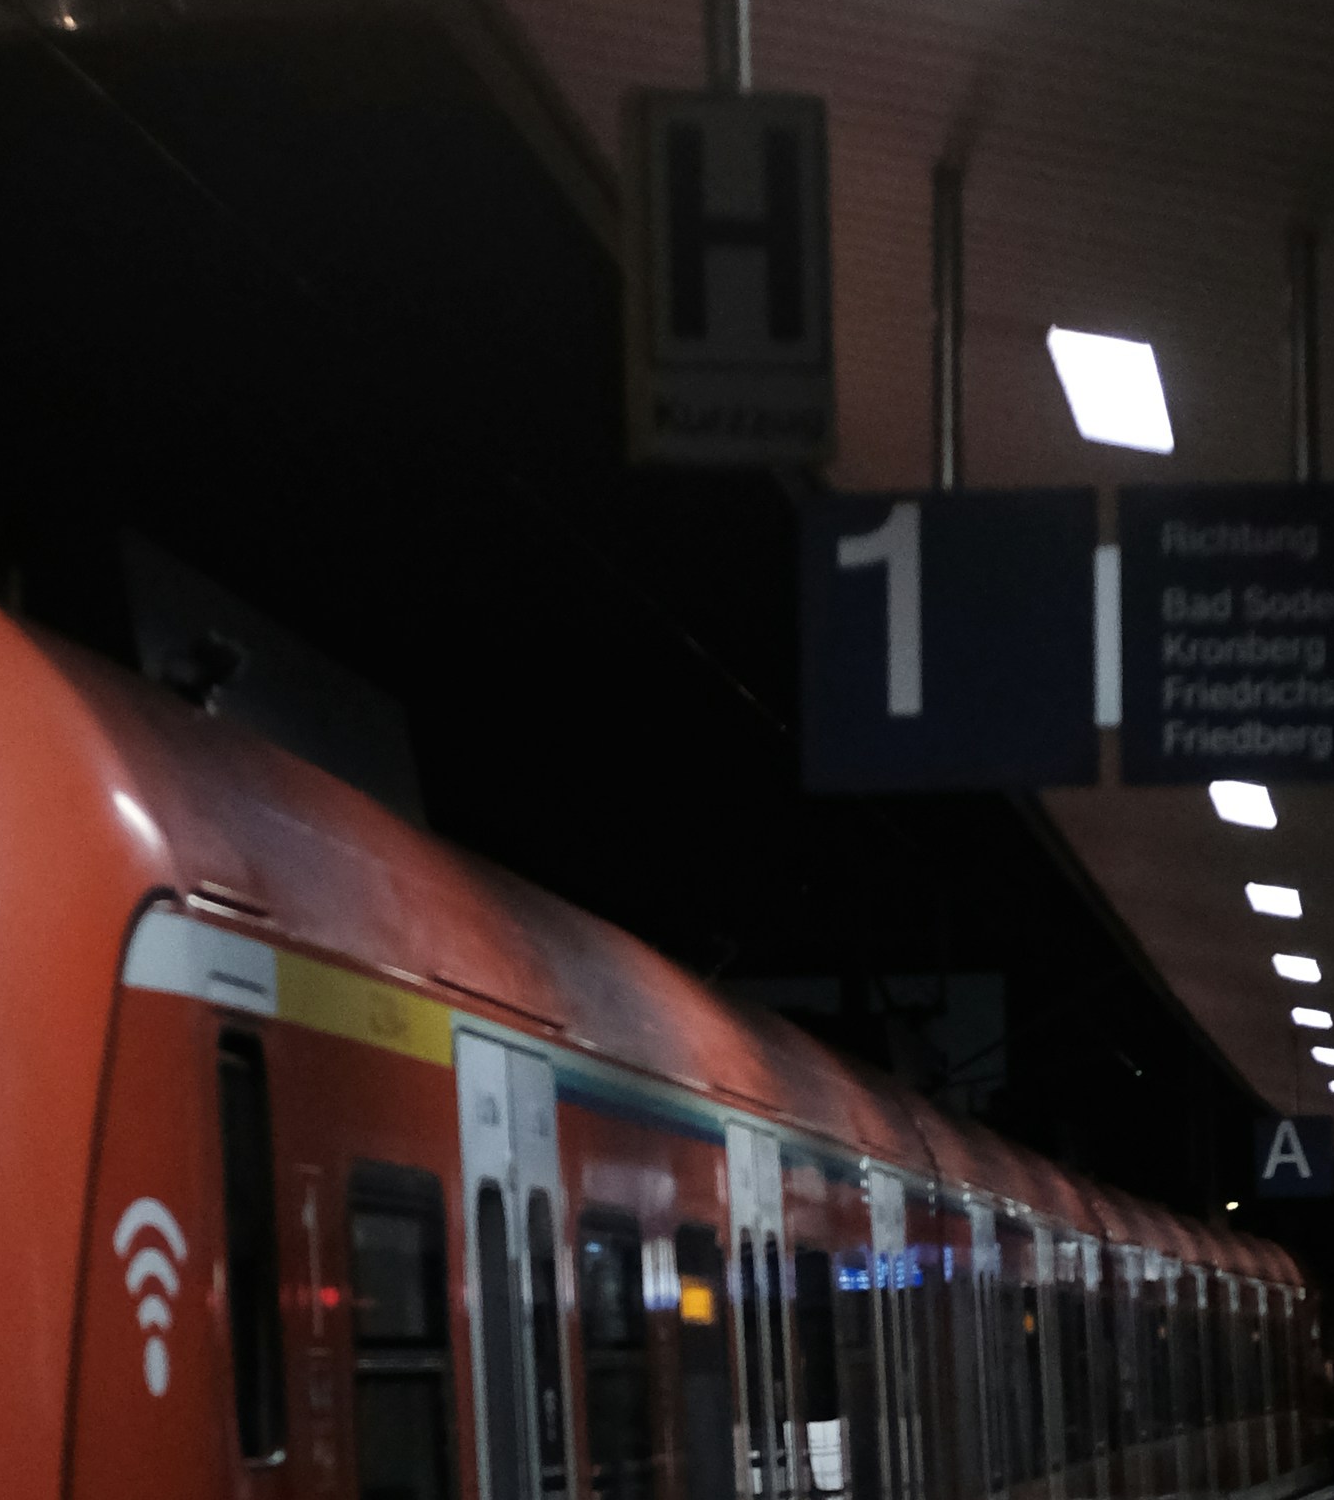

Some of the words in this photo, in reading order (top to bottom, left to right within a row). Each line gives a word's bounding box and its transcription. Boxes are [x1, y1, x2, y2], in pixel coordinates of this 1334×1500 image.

[669, 122, 805, 341] H
[1162, 522, 1319, 561] Richtung
[837, 502, 923, 718] 1
[1162, 586, 1232, 622] Bad
[1162, 632, 1327, 672] Kronberg
[1162, 720, 1333, 760] Friedberg
[1262, 1117, 1314, 1181] A
